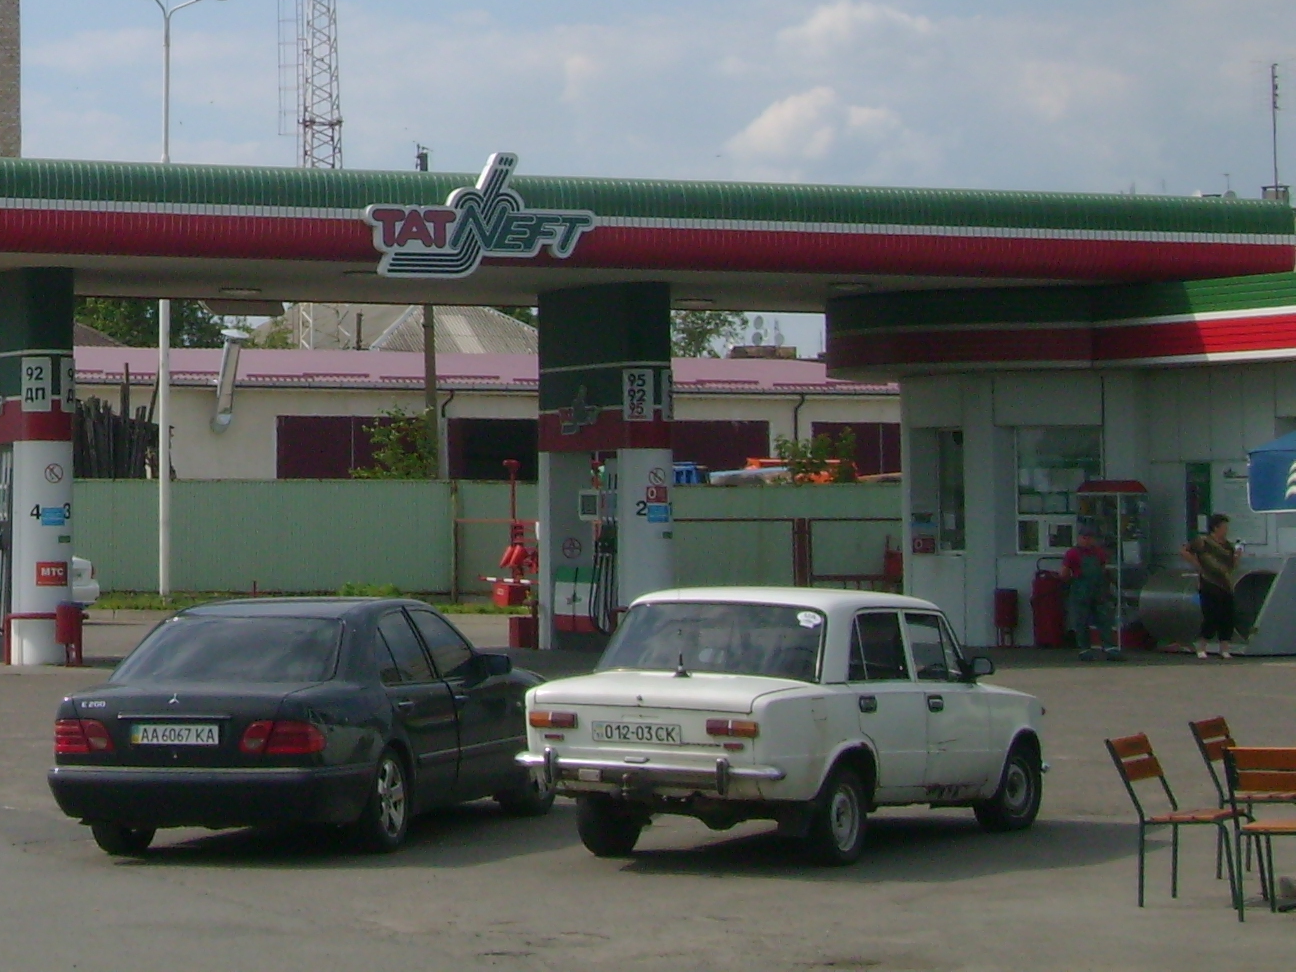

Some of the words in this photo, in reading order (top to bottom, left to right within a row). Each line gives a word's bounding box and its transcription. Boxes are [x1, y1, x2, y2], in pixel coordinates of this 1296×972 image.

[26, 366, 44, 381] 92
[627, 373, 646, 387] 95
[25, 387, 46, 403] ДП
[627, 388, 646, 403] 92
[628, 402, 644, 415] 95
[30, 503, 42, 520] 4
[636, 500, 648, 516] 2
[41, 567, 64, 576] МТС
